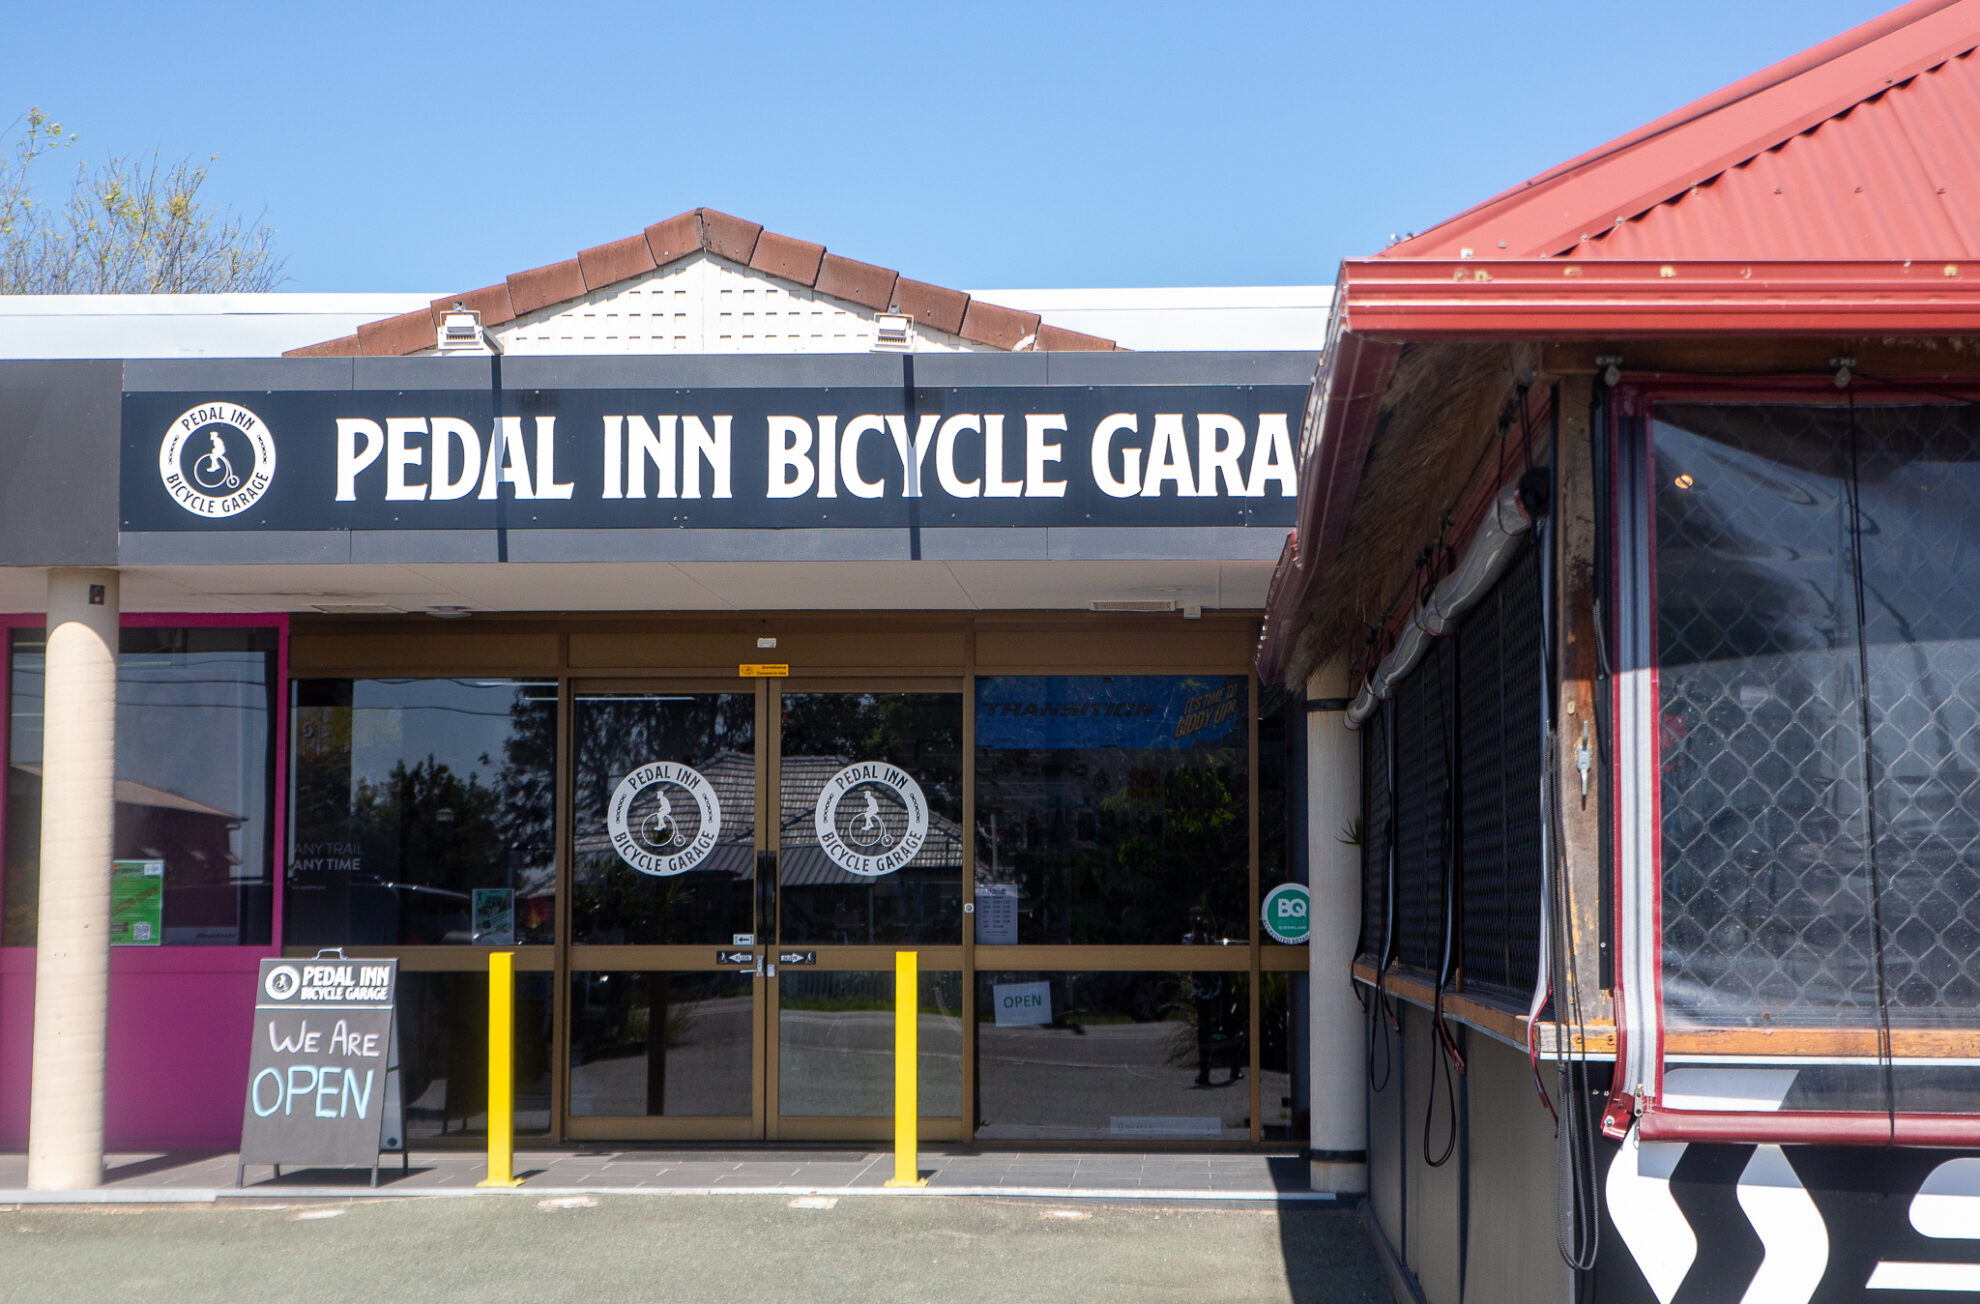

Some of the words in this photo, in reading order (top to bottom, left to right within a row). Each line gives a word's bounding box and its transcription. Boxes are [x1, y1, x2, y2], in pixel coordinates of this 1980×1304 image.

[181, 406, 225, 431] PEDAL
[230, 409, 256, 431] INN
[335, 416, 575, 501] PEDAL
[602, 414, 733, 500] INN
[766, 413, 1068, 500] BICYCLE
[1091, 413, 1299, 499] GARA
[166, 473, 216, 514] BICYCLE
[221, 472, 269, 513] GARAGE
[981, 702, 1156, 717] TRANSITION
[628, 765, 671, 790] PEDAL
[676, 768, 701, 790] INN
[835, 765, 878, 790] PEDAL
[883, 767, 909, 790] INN
[293, 843, 326, 855] ANY
[326, 843, 364, 855] TRAIL
[613, 832, 662, 872] BICYCLE
[668, 830, 715, 872] GARAGE
[821, 831, 870, 872] BICYCLE
[876, 830, 923, 872] GARAGE
[292, 858, 326, 870] ANY
[327, 858, 361, 870] TIME
[1278, 898, 1307, 917] BQ
[302, 966, 355, 987] PEDAL
[360, 966, 390, 987] INN
[301, 987, 344, 1000] BICYCLE
[345, 987, 388, 1000] GARAGE
[1003, 994, 1042, 1008] OPEN
[252, 1064, 375, 1120] OPEN
